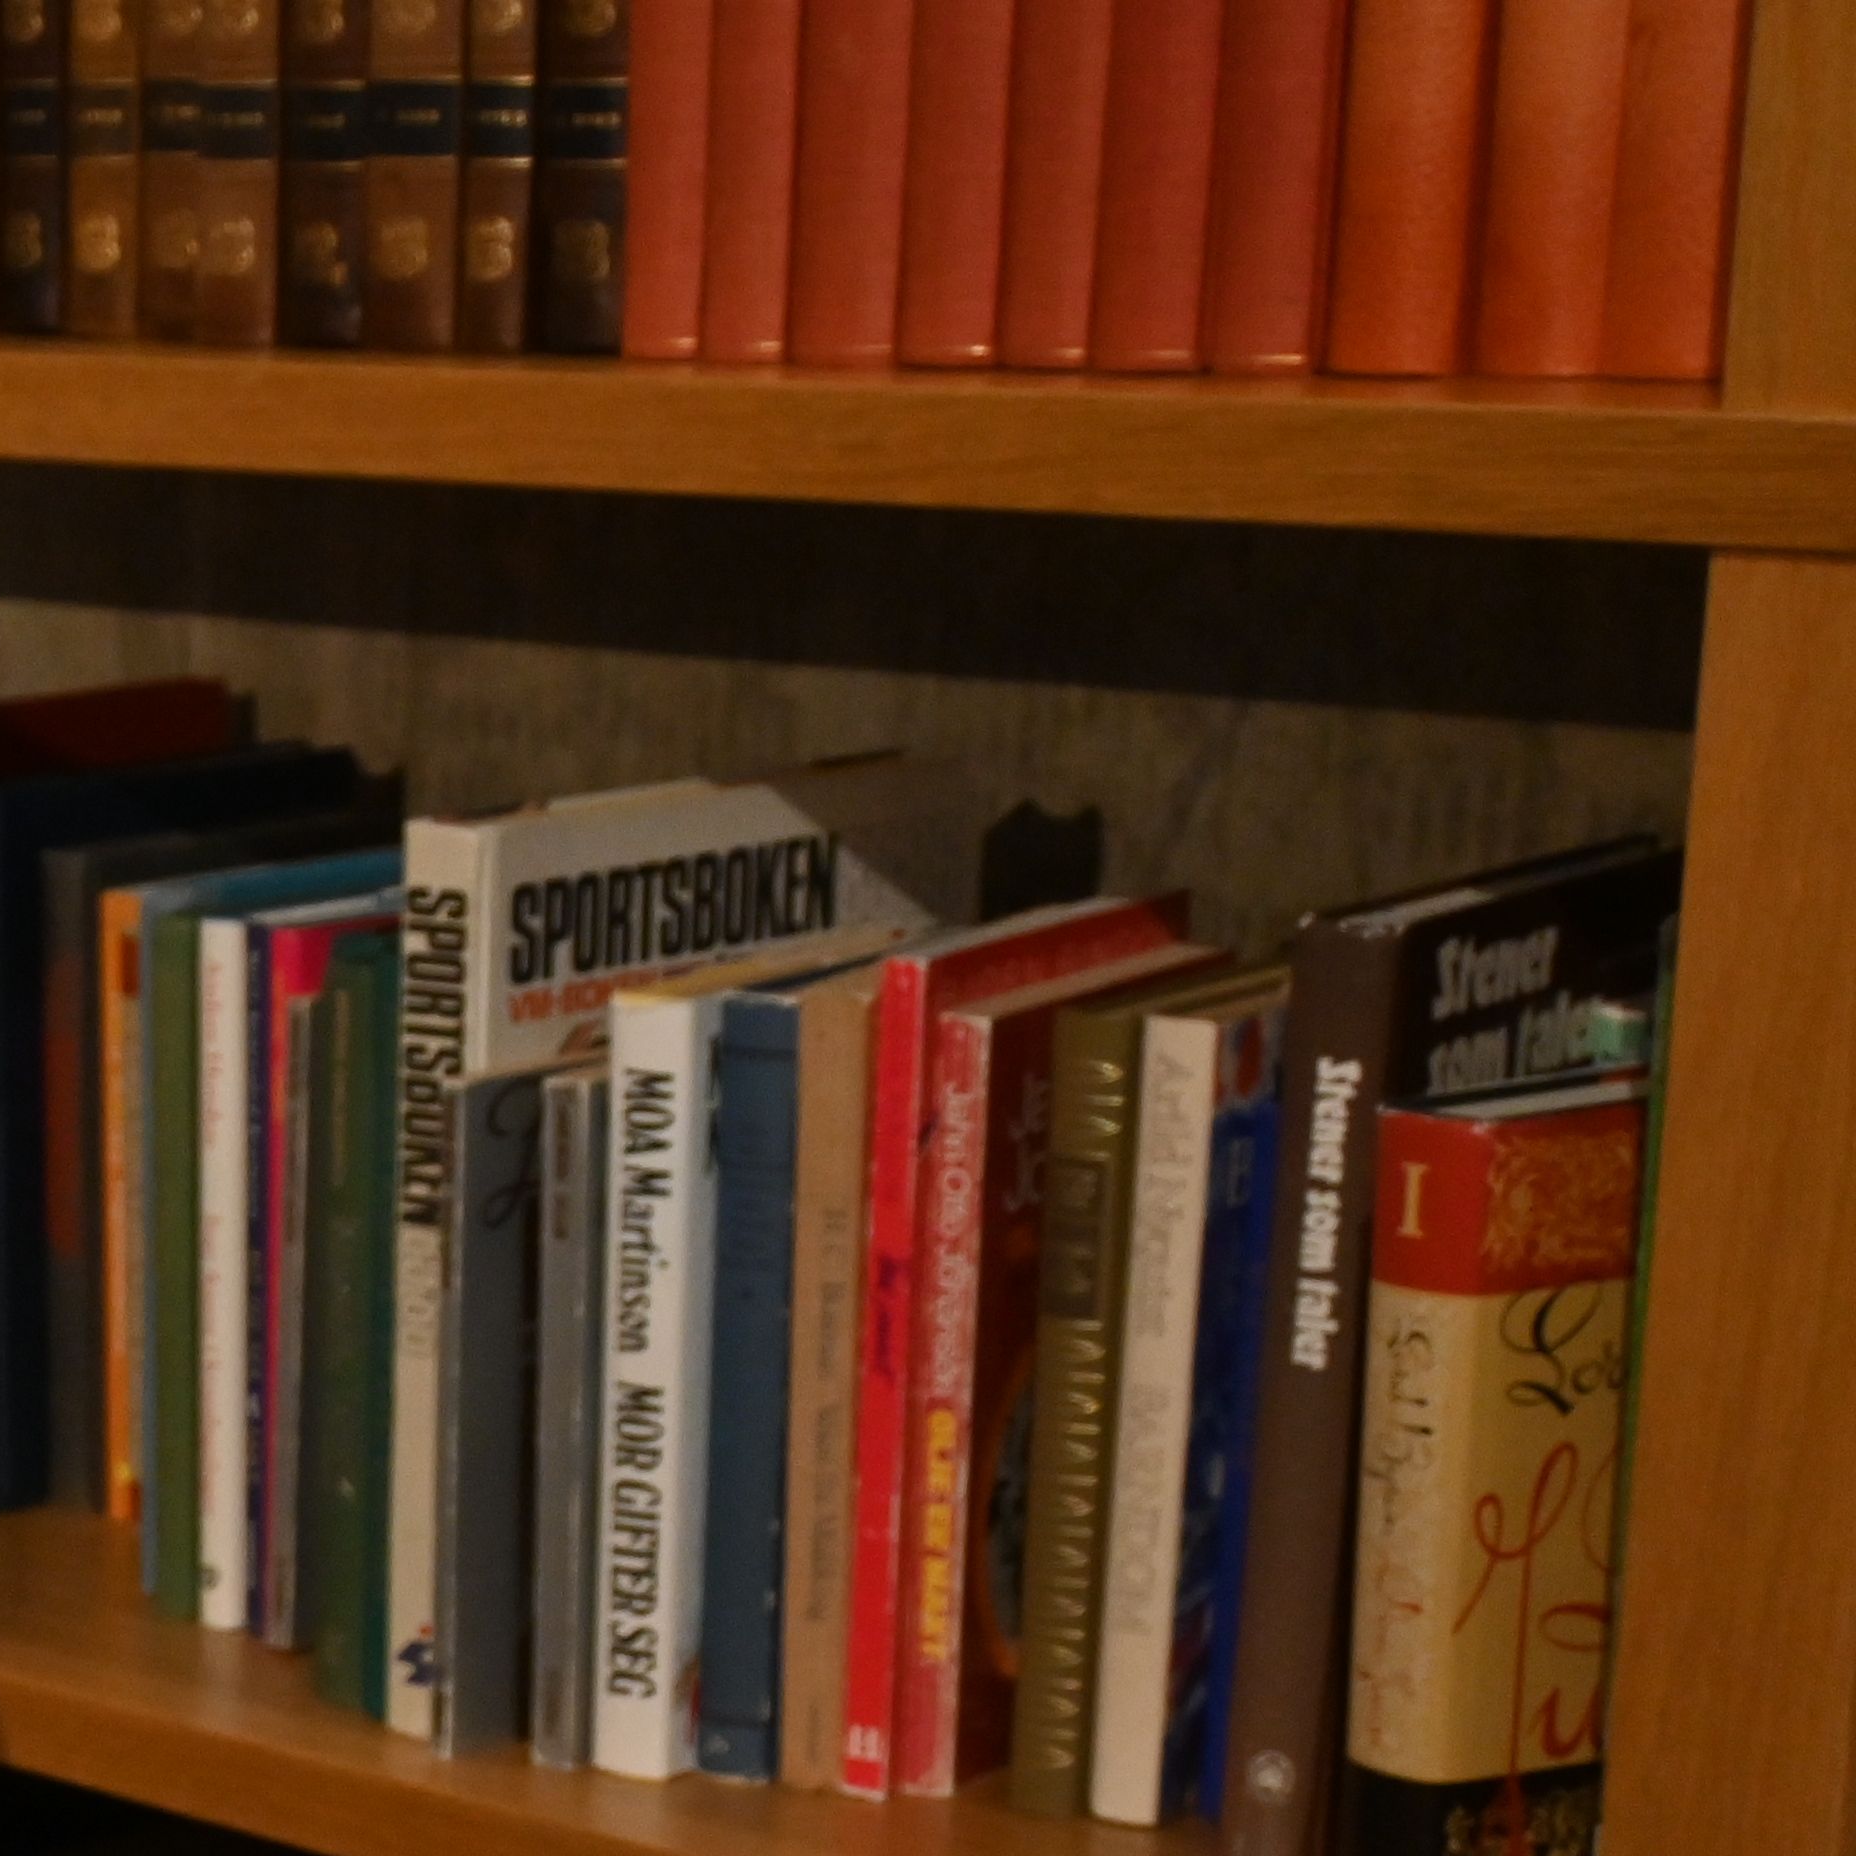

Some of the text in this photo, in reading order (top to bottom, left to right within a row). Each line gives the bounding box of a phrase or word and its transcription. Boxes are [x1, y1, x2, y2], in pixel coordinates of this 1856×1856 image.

[508, 832, 839, 984] SPORTSBOKEN
[1430, 925, 1560, 1022] Stener
[1310, 1056, 1363, 1184] Stener
[1300, 1186, 1344, 1273] som
[1395, 1162, 1426, 1239] I
[608, 1067, 674, 1701] MOA Martinson MOR GIFTER SEG
